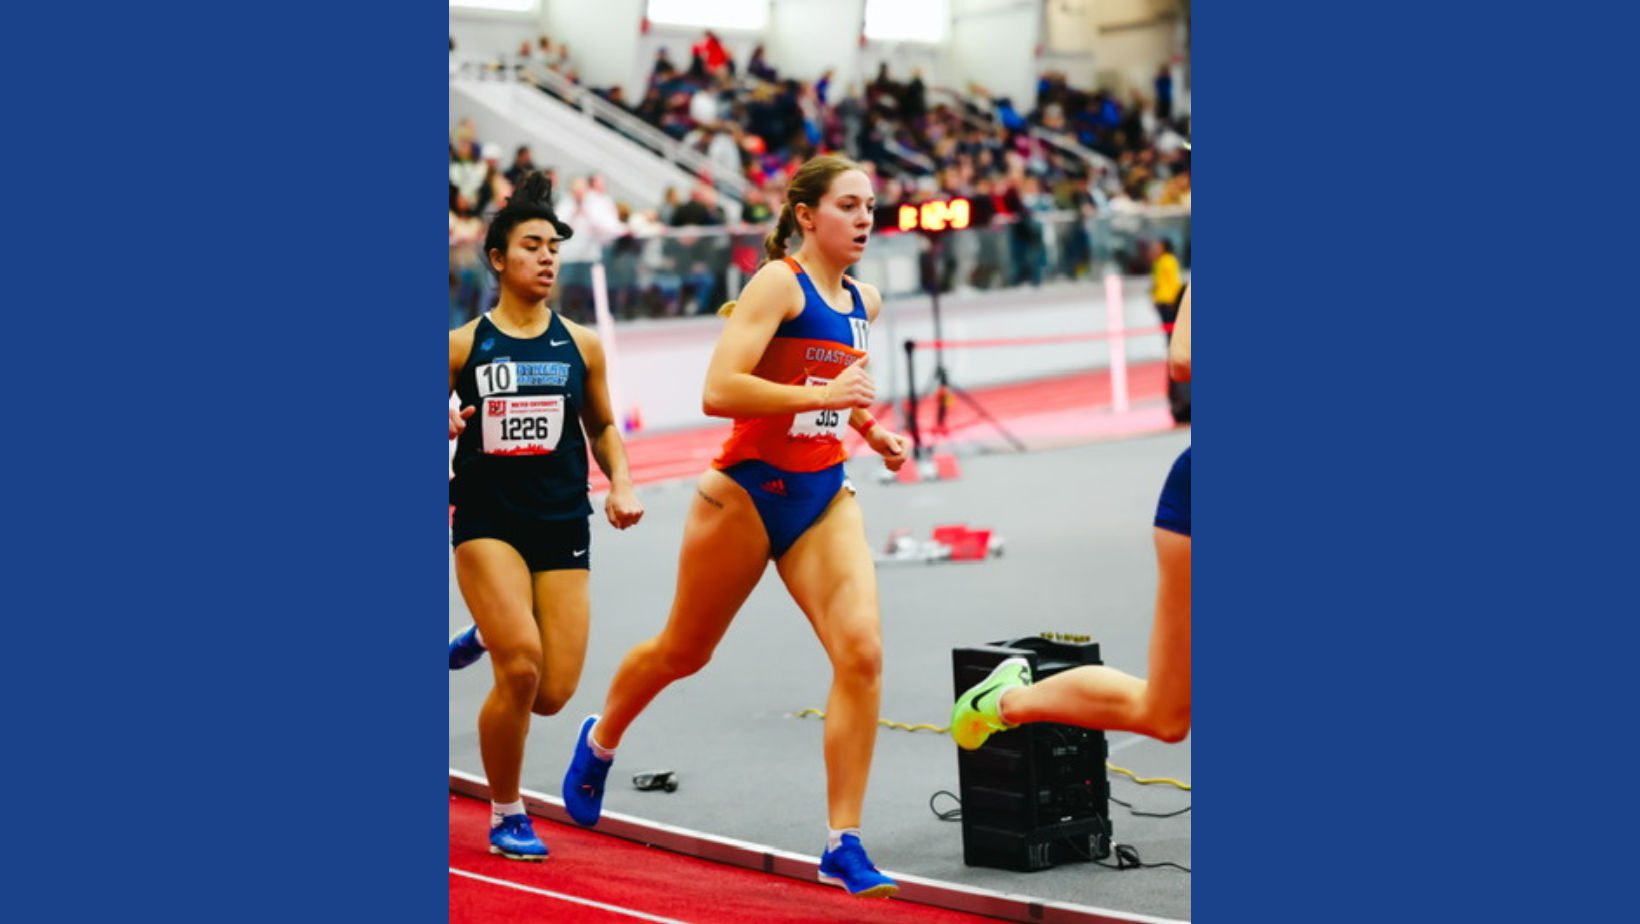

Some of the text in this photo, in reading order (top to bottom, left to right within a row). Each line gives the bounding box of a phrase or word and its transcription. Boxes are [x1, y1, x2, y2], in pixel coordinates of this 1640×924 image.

[855, 318, 869, 350] 11
[806, 346, 845, 364] COAST
[483, 363, 511, 393] 10
[488, 400, 507, 417] BU
[815, 410, 839, 427] 315
[501, 417, 548, 440] 1226
